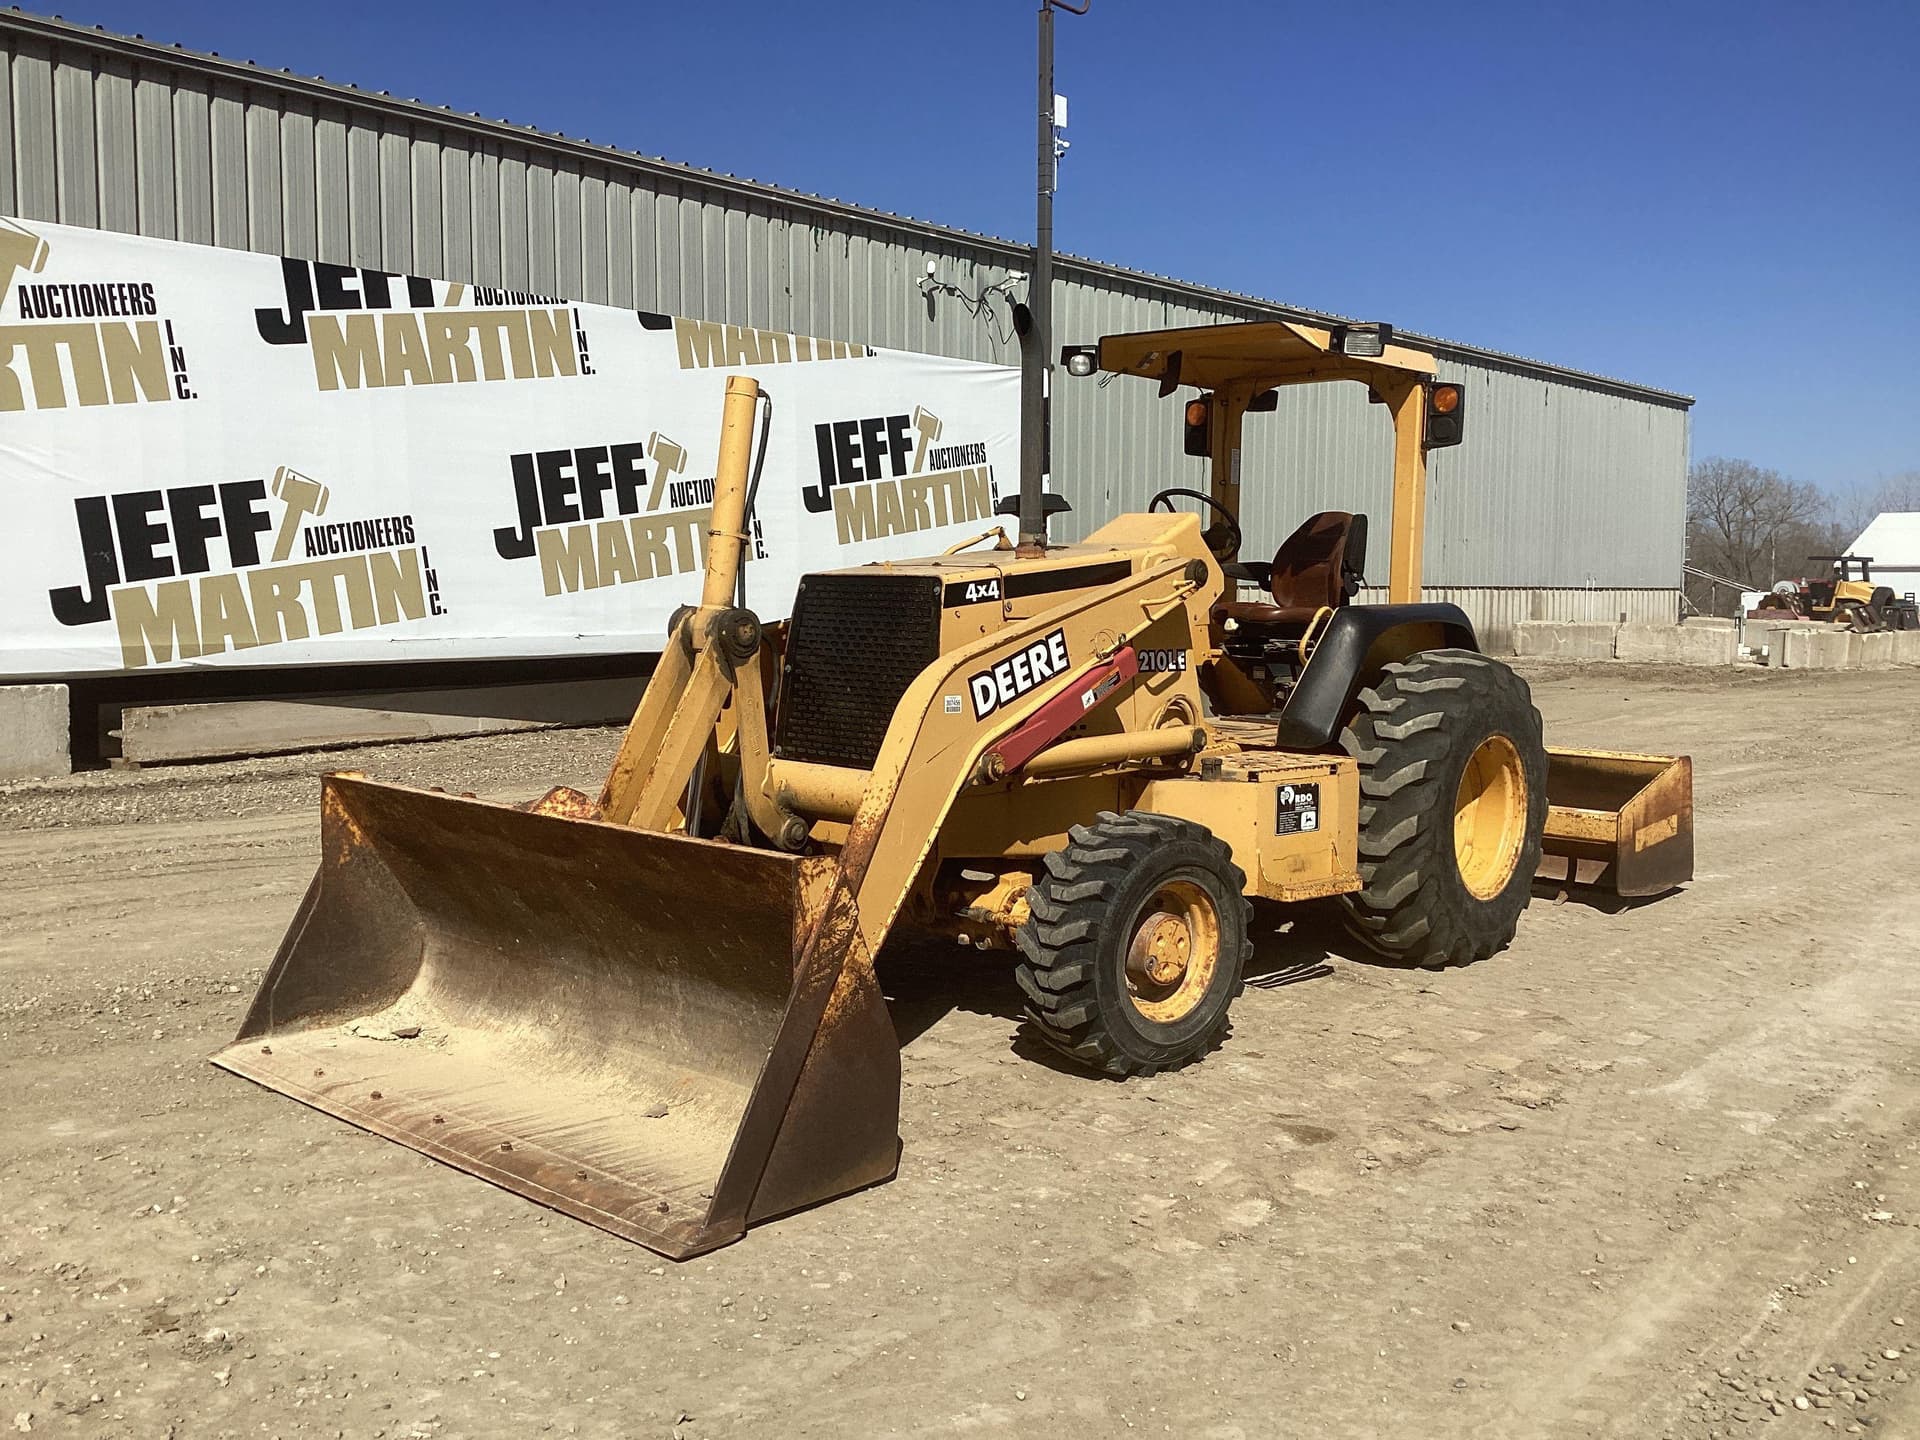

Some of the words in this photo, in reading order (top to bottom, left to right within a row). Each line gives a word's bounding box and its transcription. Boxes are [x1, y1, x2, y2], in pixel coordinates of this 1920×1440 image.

[18, 282, 157, 319] AUCTIONEERS
[165, 319, 198, 399] INC.
[308, 308, 578, 391] MARTIN
[574, 307, 596, 375] INC.
[802, 413, 913, 514] JEFF
[929, 442, 987, 472] AUCTIONEERS
[990, 464, 1000, 517] INC
[493, 442, 648, 560] JEFF
[832, 466, 991, 545] MARTIN
[49, 479, 273, 626] JEFF
[304, 515, 416, 558] AUCTIONEERS
[111, 548, 427, 669] MARTIN
[421, 546, 448, 616] INC.
[965, 580, 1000, 602] 4x4
[969, 630, 1069, 719] DEERE
[1139, 650, 1186, 671] 210LE
[1295, 793, 1313, 803] RDO
